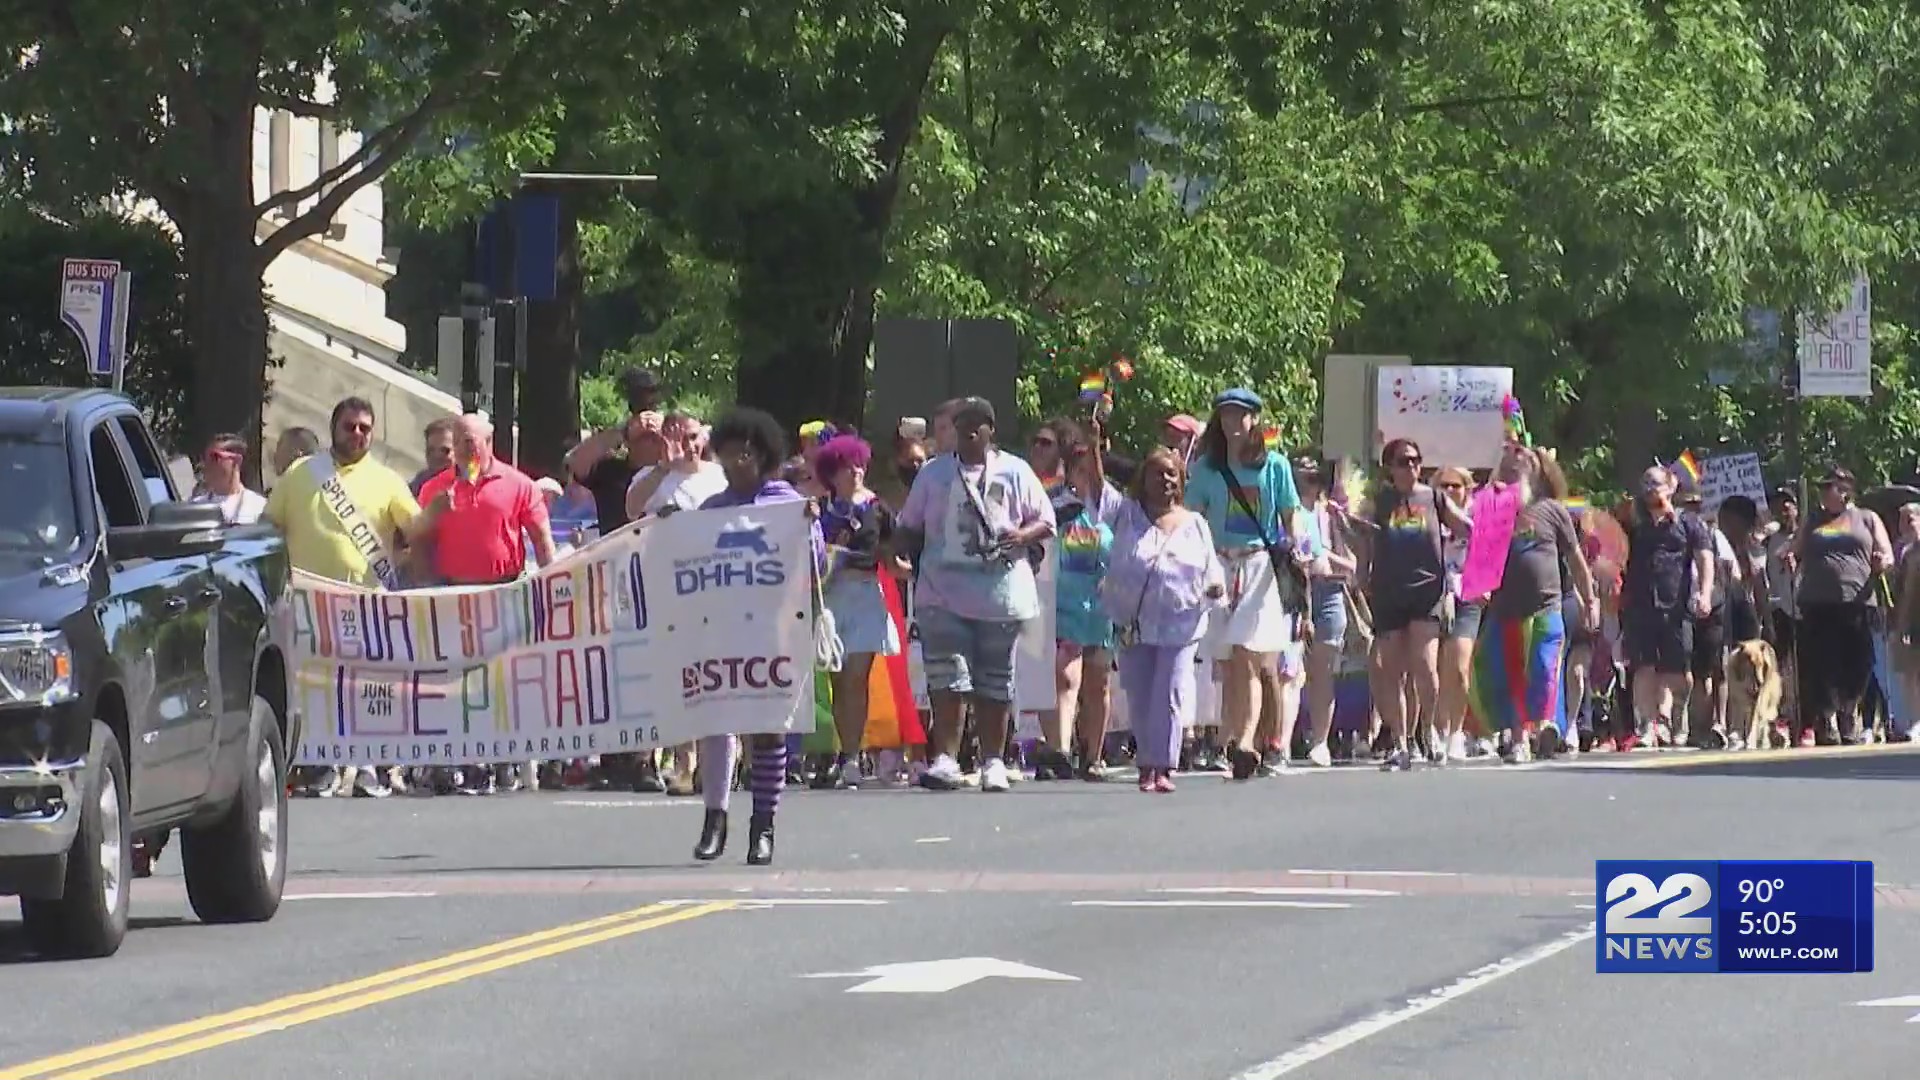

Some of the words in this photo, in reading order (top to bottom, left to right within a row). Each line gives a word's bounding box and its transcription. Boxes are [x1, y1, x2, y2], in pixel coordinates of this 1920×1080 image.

[67, 263, 88, 278] BUS
[91, 264, 116, 279] STOP
[351, 521, 381, 556] CITY
[675, 559, 785, 595] DHHS
[555, 586, 572, 598] MA
[461, 638, 653, 734] PARADE
[702, 656, 793, 692] STCC
[361, 683, 395, 699] JUNE
[367, 700, 392, 717] 4TH
